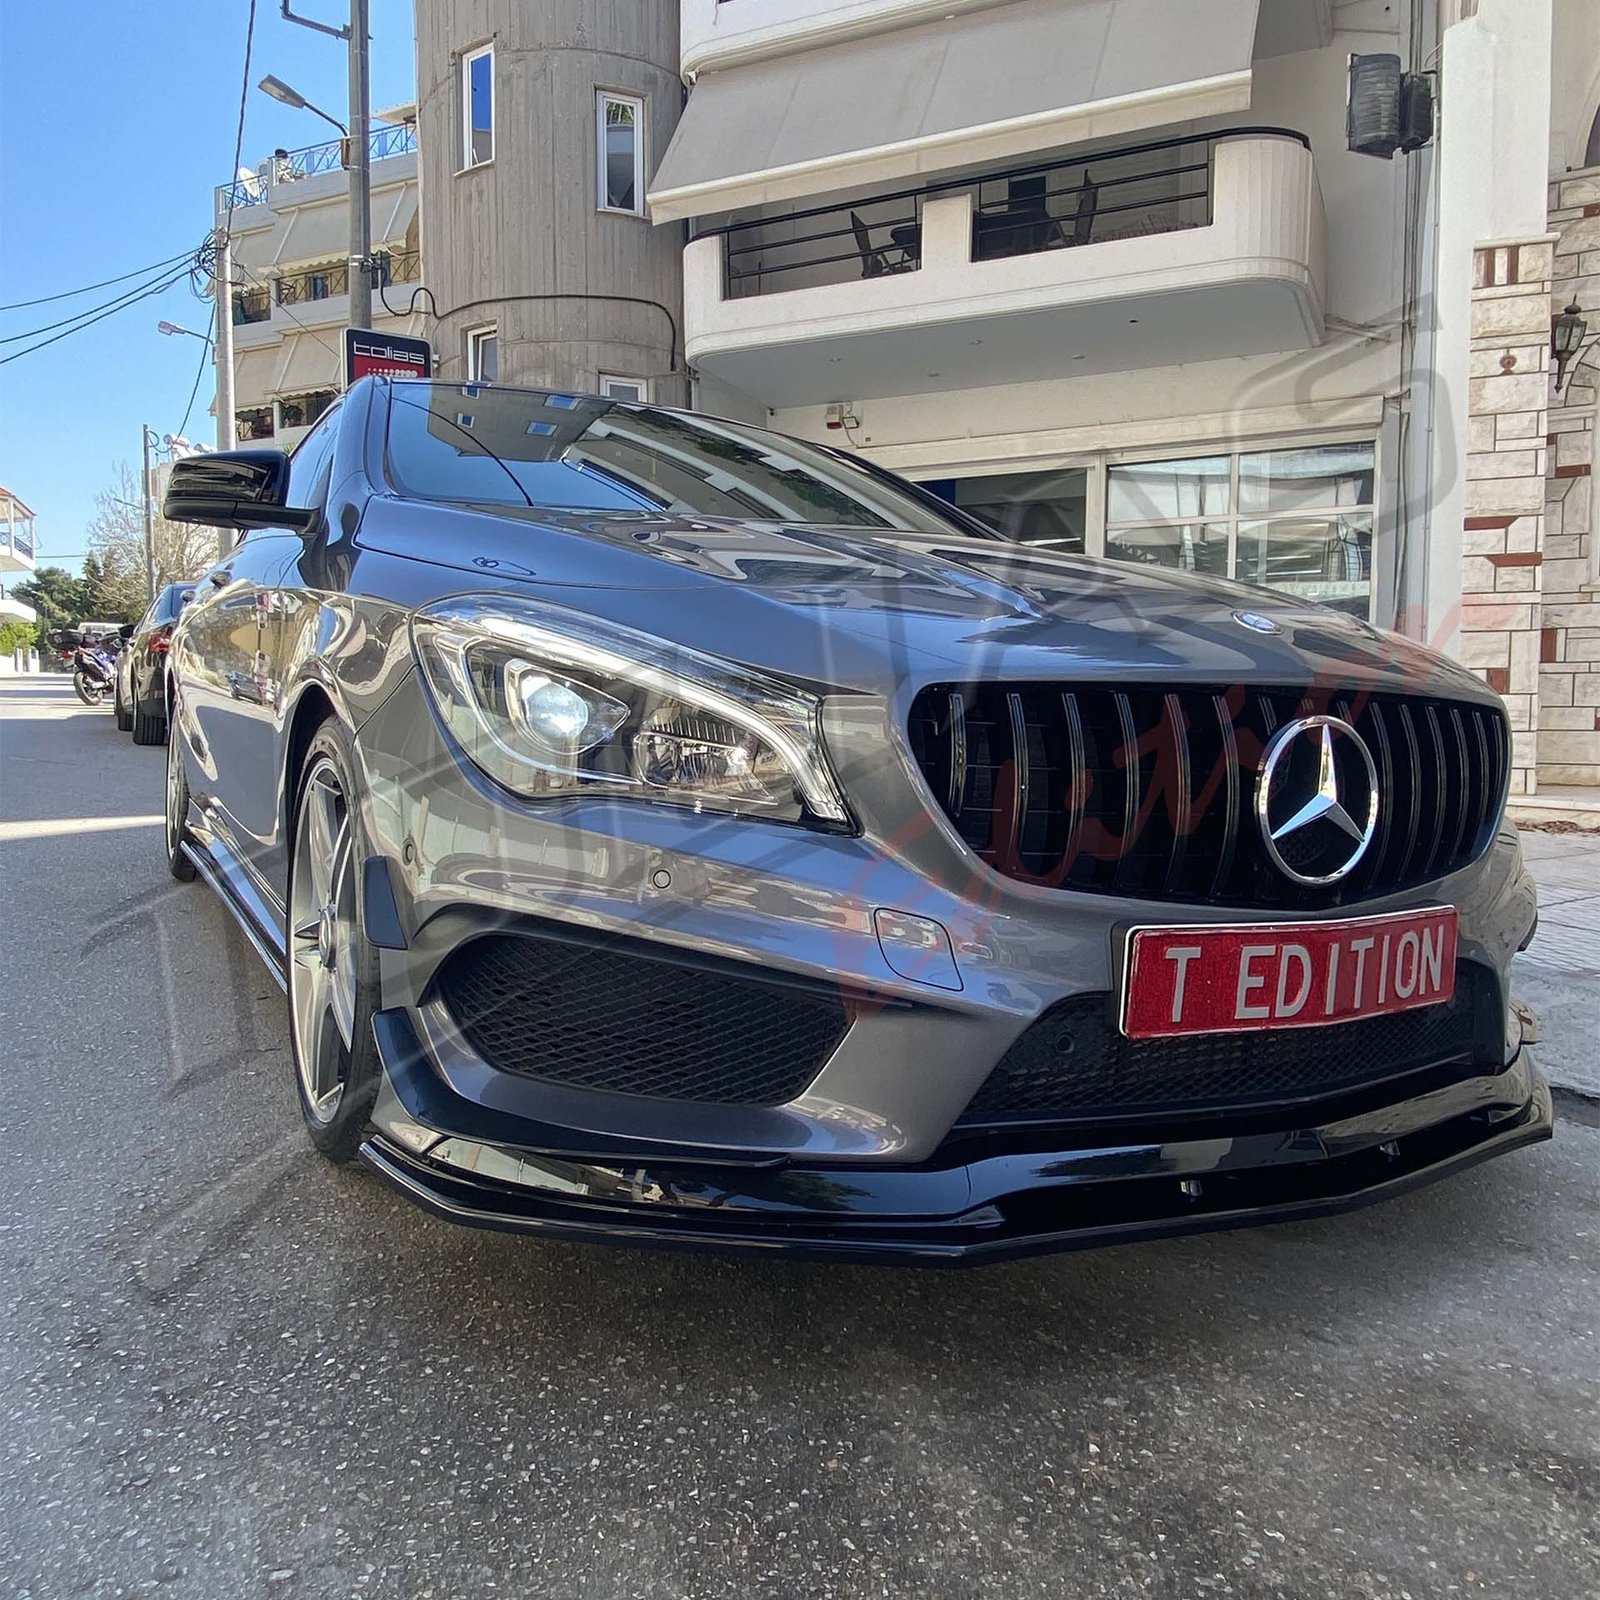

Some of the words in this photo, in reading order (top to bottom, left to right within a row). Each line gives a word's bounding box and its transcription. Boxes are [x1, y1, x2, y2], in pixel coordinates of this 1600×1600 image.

[353, 340, 425, 365] tolias
[1165, 946, 1202, 1024] T
[1233, 924, 1445, 1020] EDITION
